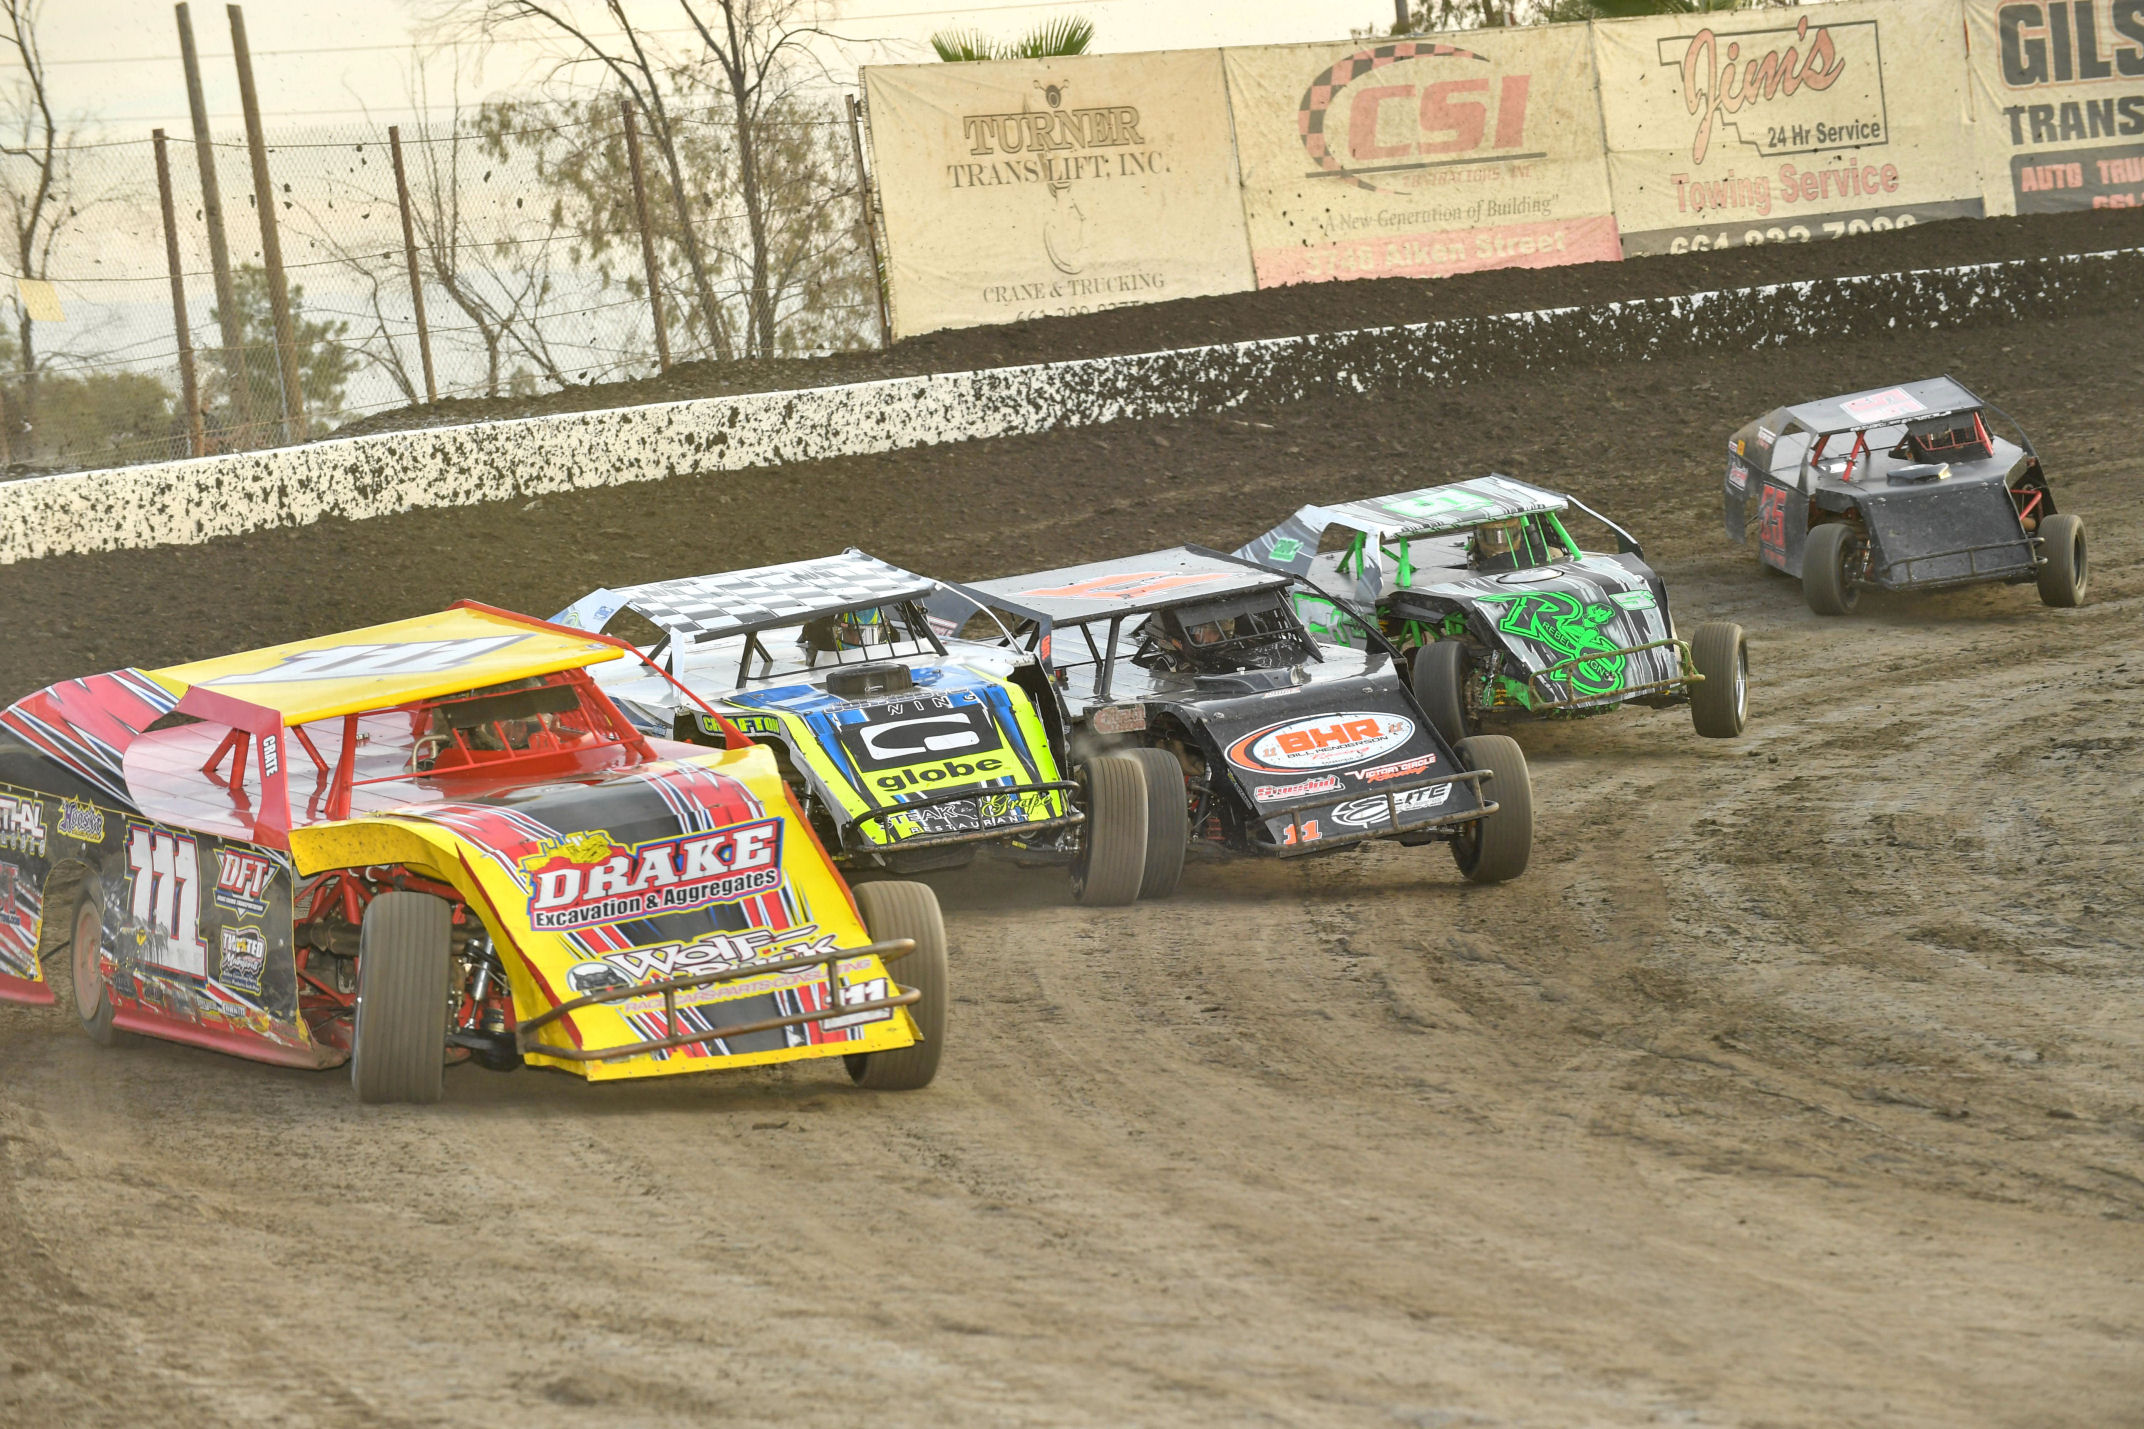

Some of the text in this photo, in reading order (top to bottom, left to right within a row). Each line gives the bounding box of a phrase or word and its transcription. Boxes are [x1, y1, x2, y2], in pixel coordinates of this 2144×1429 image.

[1683, 15, 1845, 165] Jim's
[963, 105, 1145, 156] TURNER
[1348, 74, 1531, 161] CSI
[1767, 121, 1881, 148] 24 Hr Service
[2003, 95, 2144, 146] TRANS
[1120, 150, 1171, 176] INC.
[2021, 162, 2083, 192] AUTO
[1670, 157, 1900, 216] Towing Service
[1377, 202, 1462, 231] Generation
[1467, 200, 1483, 223] of
[1386, 240, 1466, 267] Aiken
[1476, 231, 1567, 259] Street
[983, 272, 1165, 304] CRANE & TRUCKING
[1542, 620, 1572, 649] REBEL
[1275, 718, 1386, 755] BHR
[262, 734, 279, 777] CRATE
[1345, 754, 1436, 781] VICTORY CIRCLE
[877, 758, 1003, 792] globe
[910, 814, 1029, 833] RESTAURANT
[981, 793, 1053, 818] Grape
[1283, 820, 1322, 845] 11
[219, 849, 269, 897] DFT
[533, 823, 778, 910] DRAKE
[130, 828, 208, 980] 111
[535, 868, 777, 928] Excavation & Aggregates
